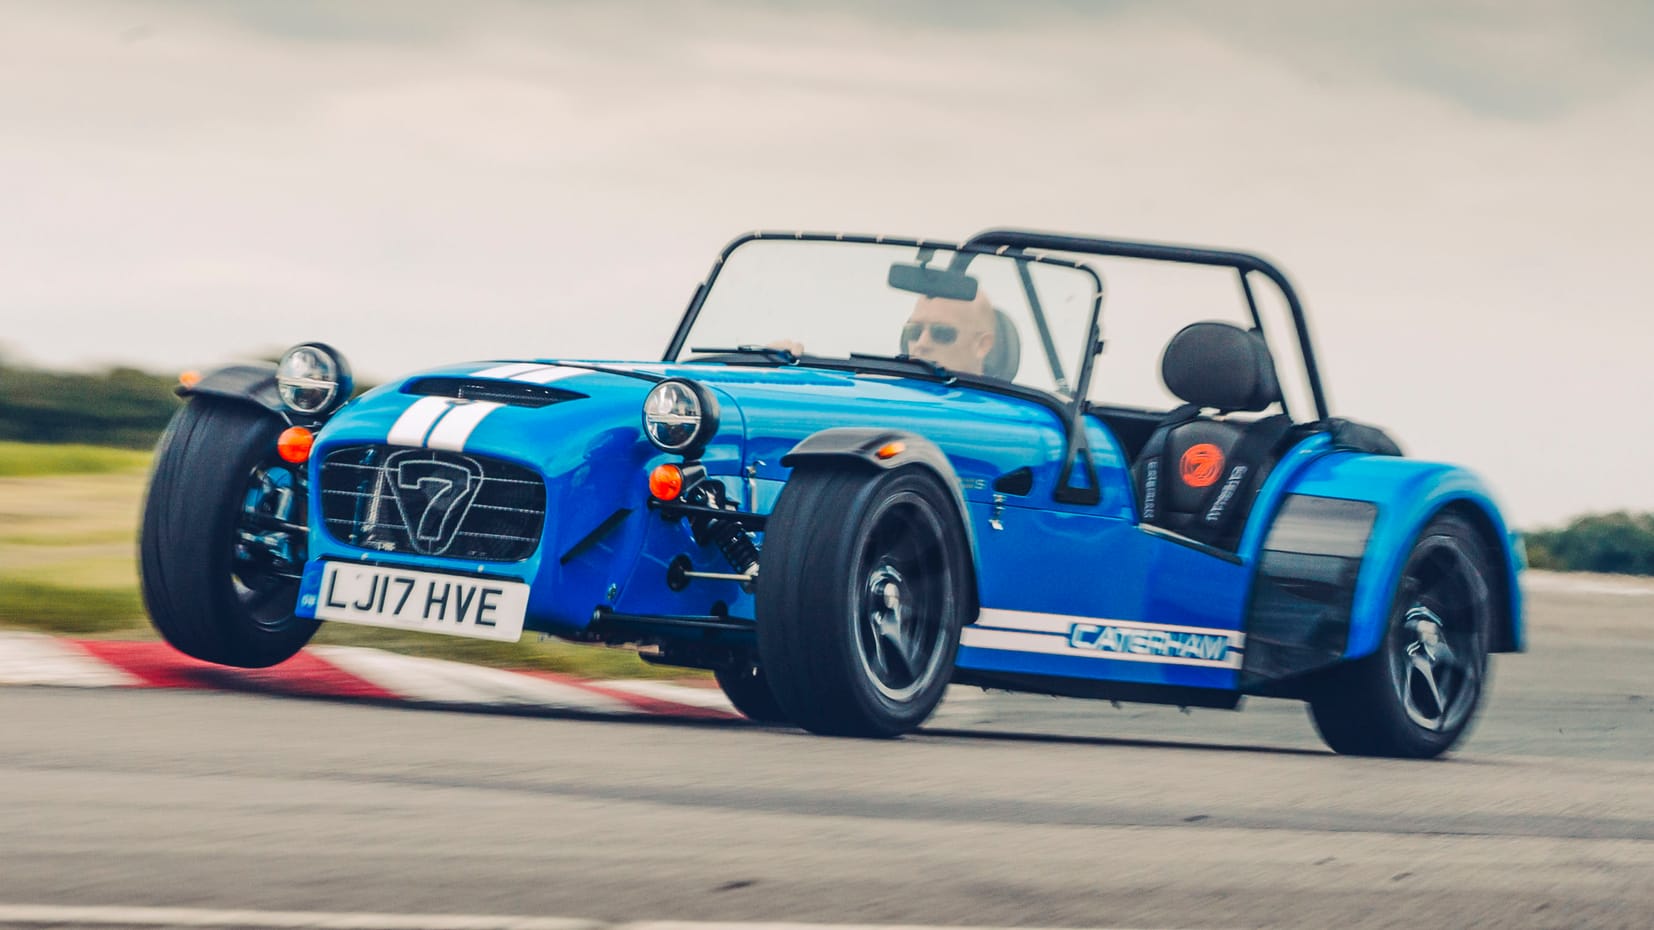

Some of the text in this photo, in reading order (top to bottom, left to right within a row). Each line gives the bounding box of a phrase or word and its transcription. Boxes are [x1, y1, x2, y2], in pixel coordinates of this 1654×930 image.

[397, 458, 471, 542] 7
[326, 569, 504, 627] LJ17 HVE
[1070, 622, 1229, 661] CATERHAM
